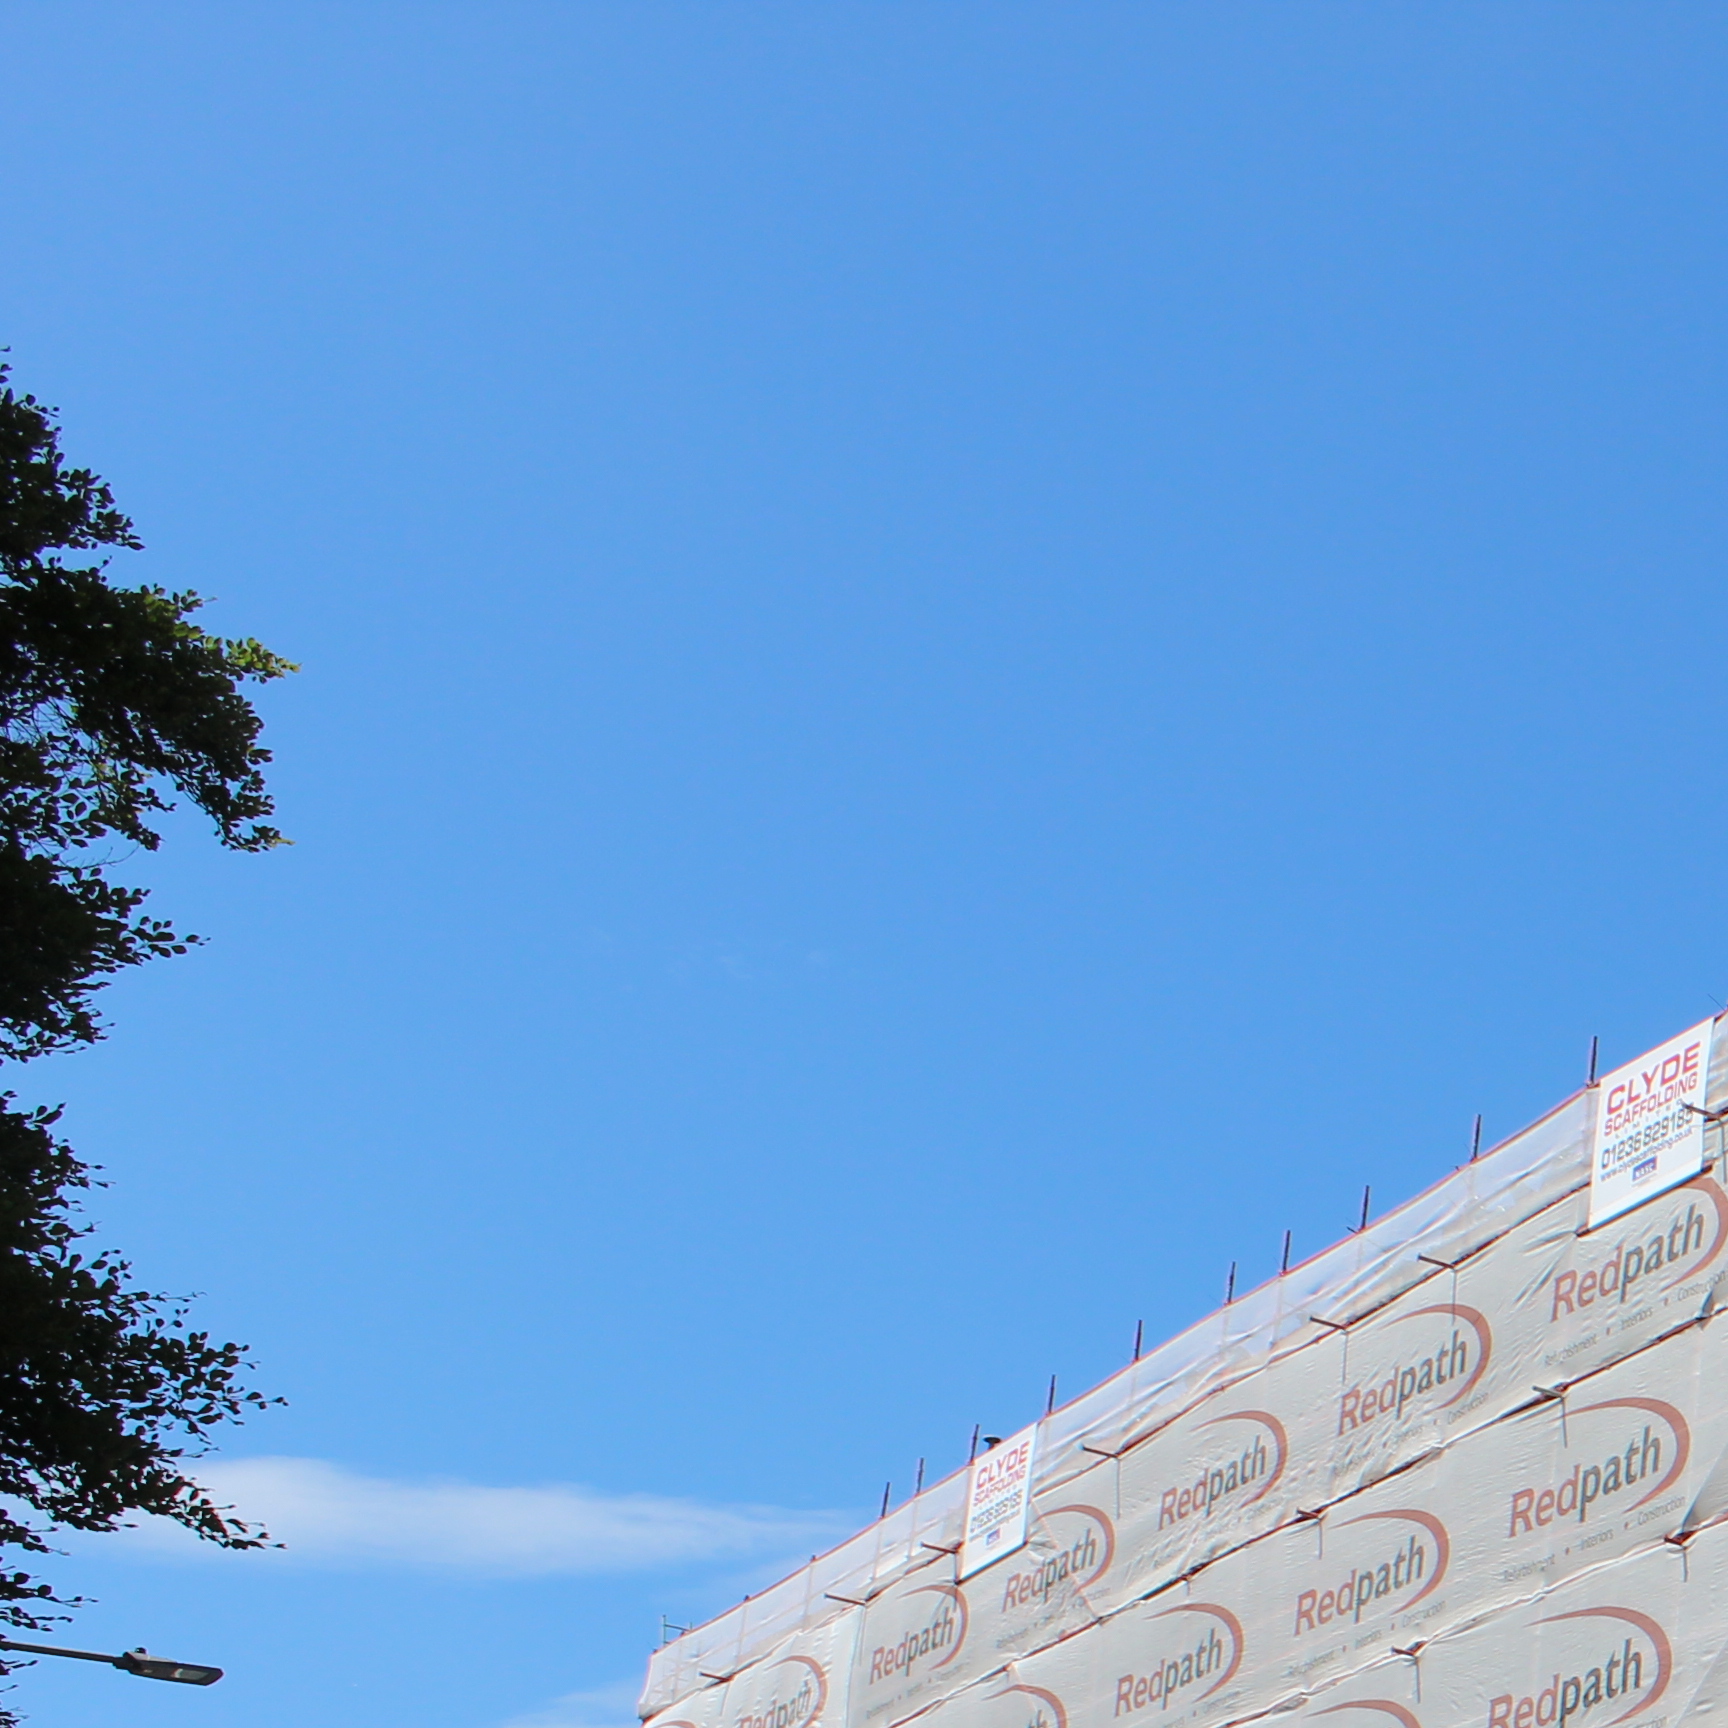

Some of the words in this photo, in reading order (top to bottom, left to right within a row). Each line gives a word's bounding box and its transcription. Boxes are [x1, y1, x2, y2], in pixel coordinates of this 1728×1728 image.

[1603, 1071, 1698, 1137] SCAFFOLDING
[1607, 1041, 1700, 1115] CLYDE
[1549, 1204, 1703, 1324] Redpath
[1337, 1329, 1467, 1436] Redpath
[977, 1440, 1030, 1489] CLYDE
[1159, 1436, 1265, 1530] Redpath
[1509, 1426, 1661, 1538] Redpath
[1003, 1529, 1096, 1612] Redpath
[1295, 1537, 1424, 1636] Redpath
[870, 1608, 955, 1684] Redpath
[1114, 1629, 1222, 1717] Redpath
